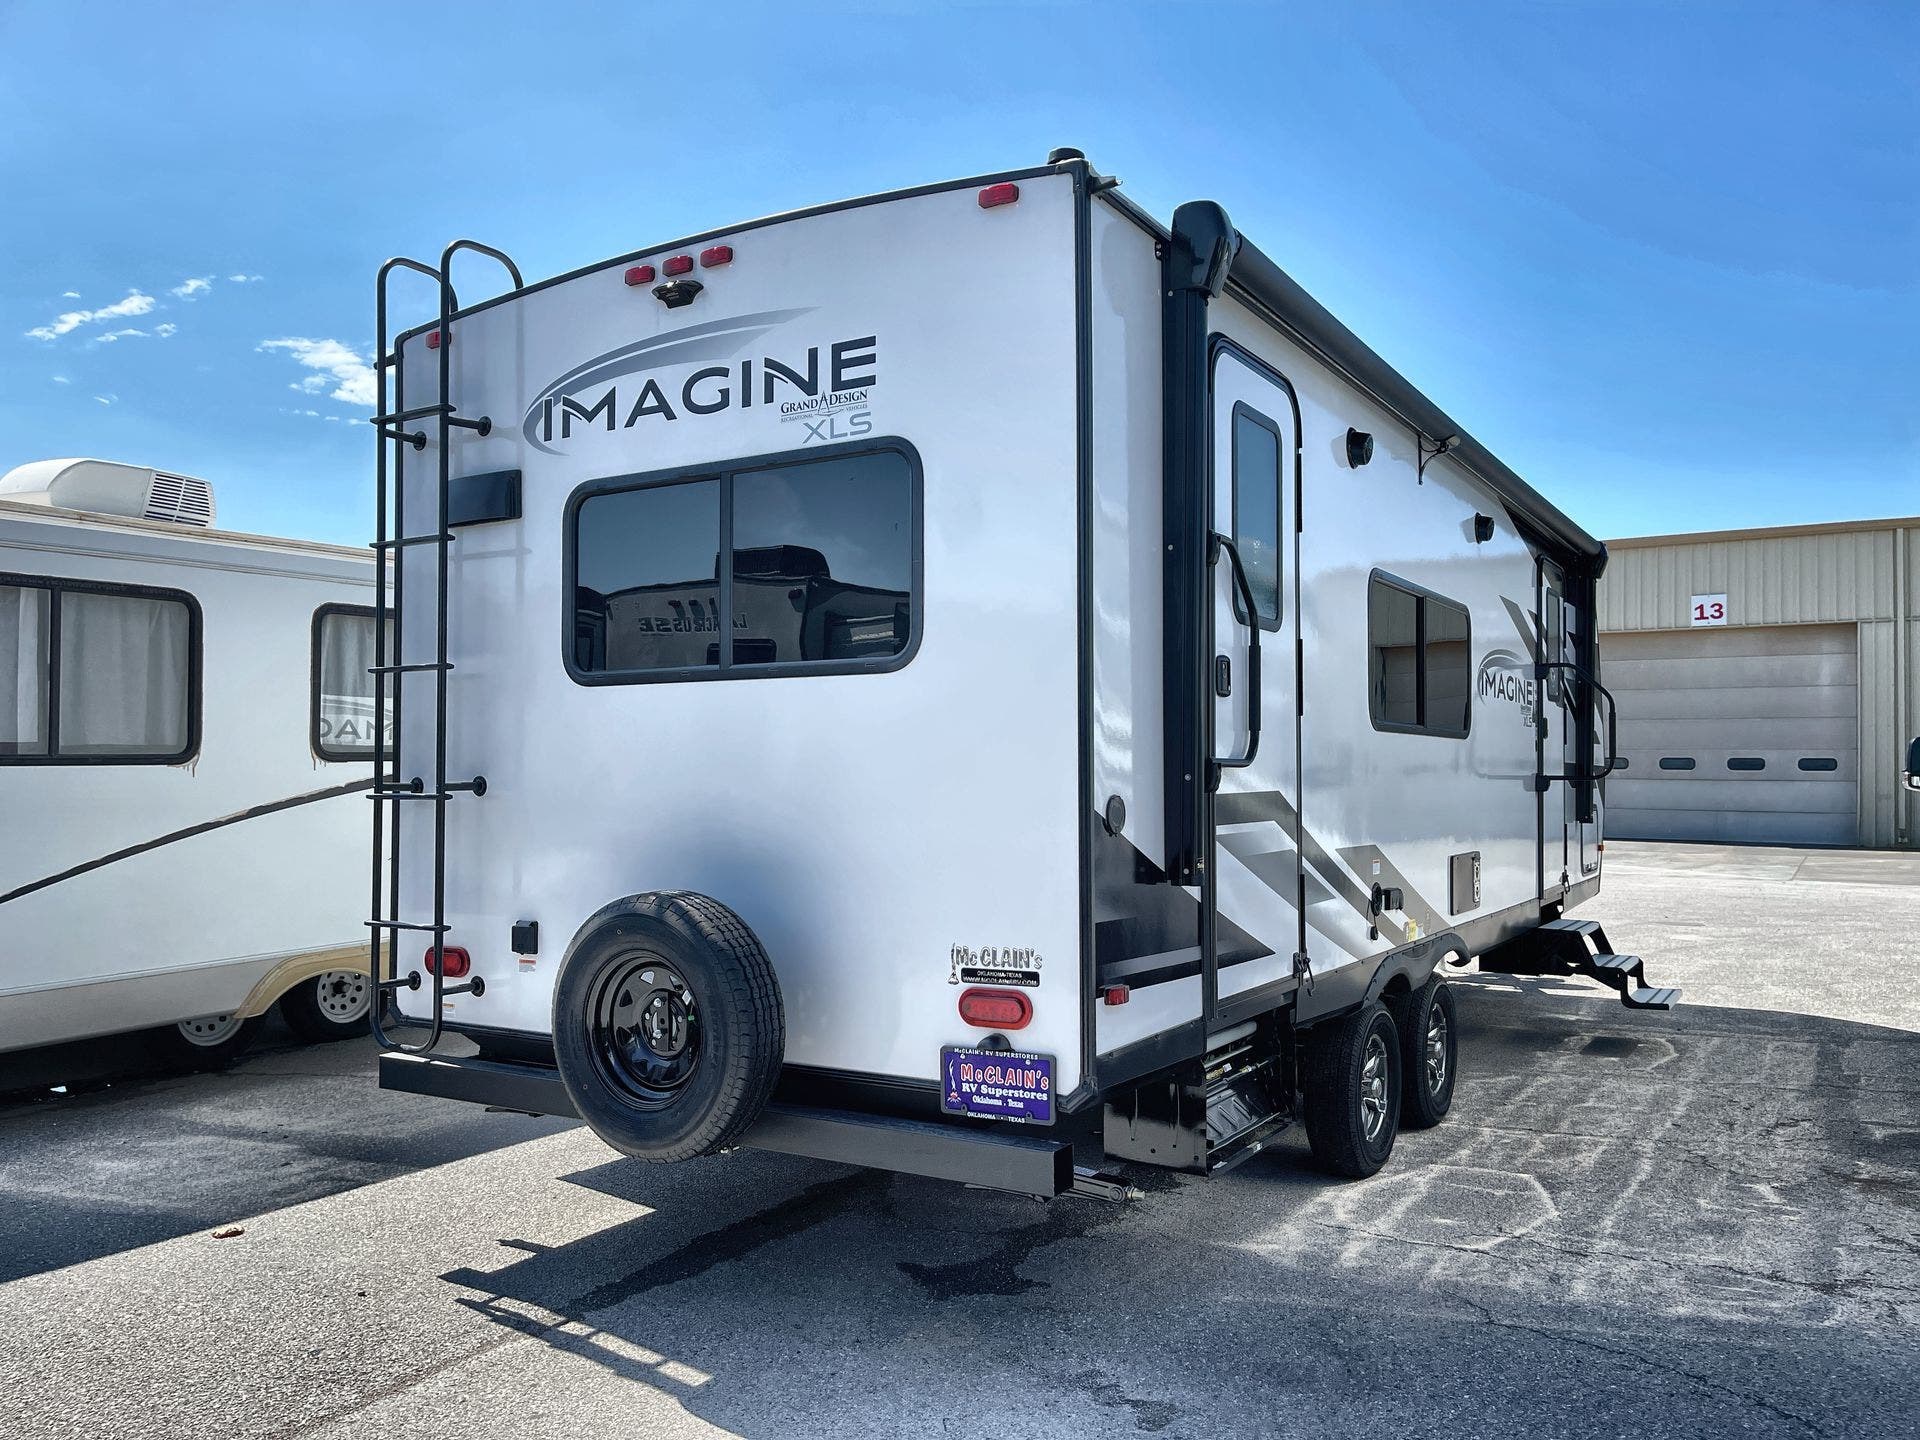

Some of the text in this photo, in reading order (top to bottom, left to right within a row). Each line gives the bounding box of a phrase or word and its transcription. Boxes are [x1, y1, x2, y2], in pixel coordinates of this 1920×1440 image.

[543, 335, 877, 442] IMAGINE
[780, 389, 868, 414] GRAND DESIGN
[802, 411, 873, 445] XLS
[1694, 602, 1724, 621] 13
[1480, 667, 1533, 707] IMAGINE
[995, 1051, 1039, 1060] SUPERSTORES
[961, 1082, 1048, 1101] RV Superstores
[972, 1094, 1024, 1109] Oklahoma Texas
[967, 1111, 1025, 1124] OKLAHOMA TEXAS
